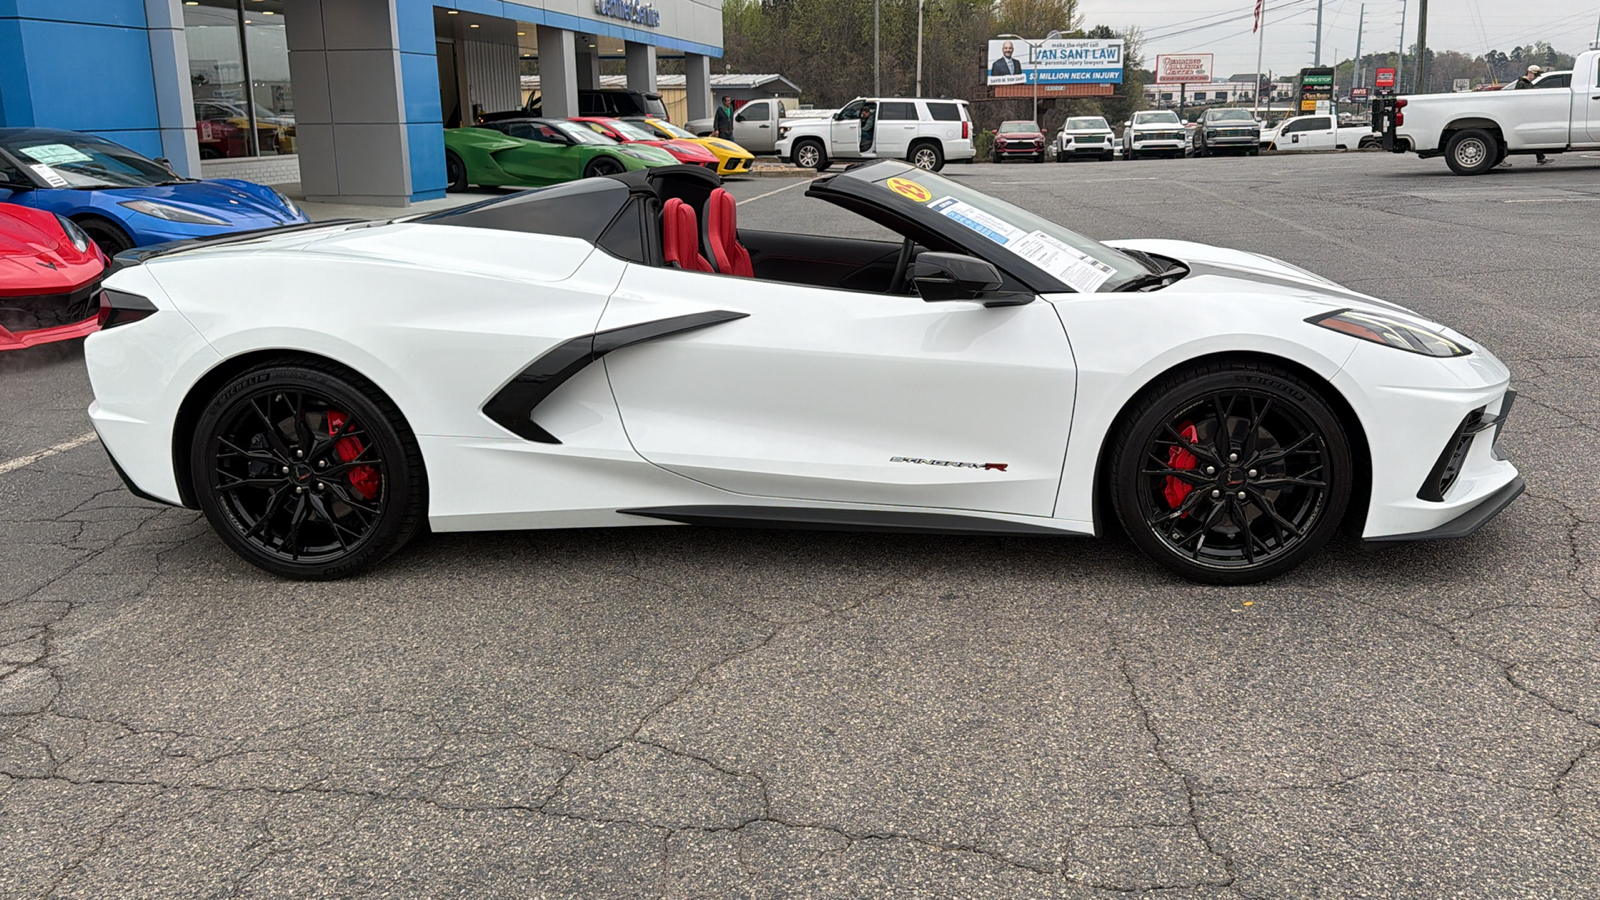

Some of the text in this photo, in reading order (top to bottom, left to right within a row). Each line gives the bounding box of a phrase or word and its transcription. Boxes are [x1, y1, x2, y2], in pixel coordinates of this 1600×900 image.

[1035, 48, 1117, 60] VAN SANT LAW
[1039, 72, 1070, 80] MILLION
[1070, 72, 1091, 80] NECK
[1092, 71, 1120, 79] INJURY
[221, 373, 270, 402] MICHELIN
[1248, 376, 1307, 402] MICHELIN
